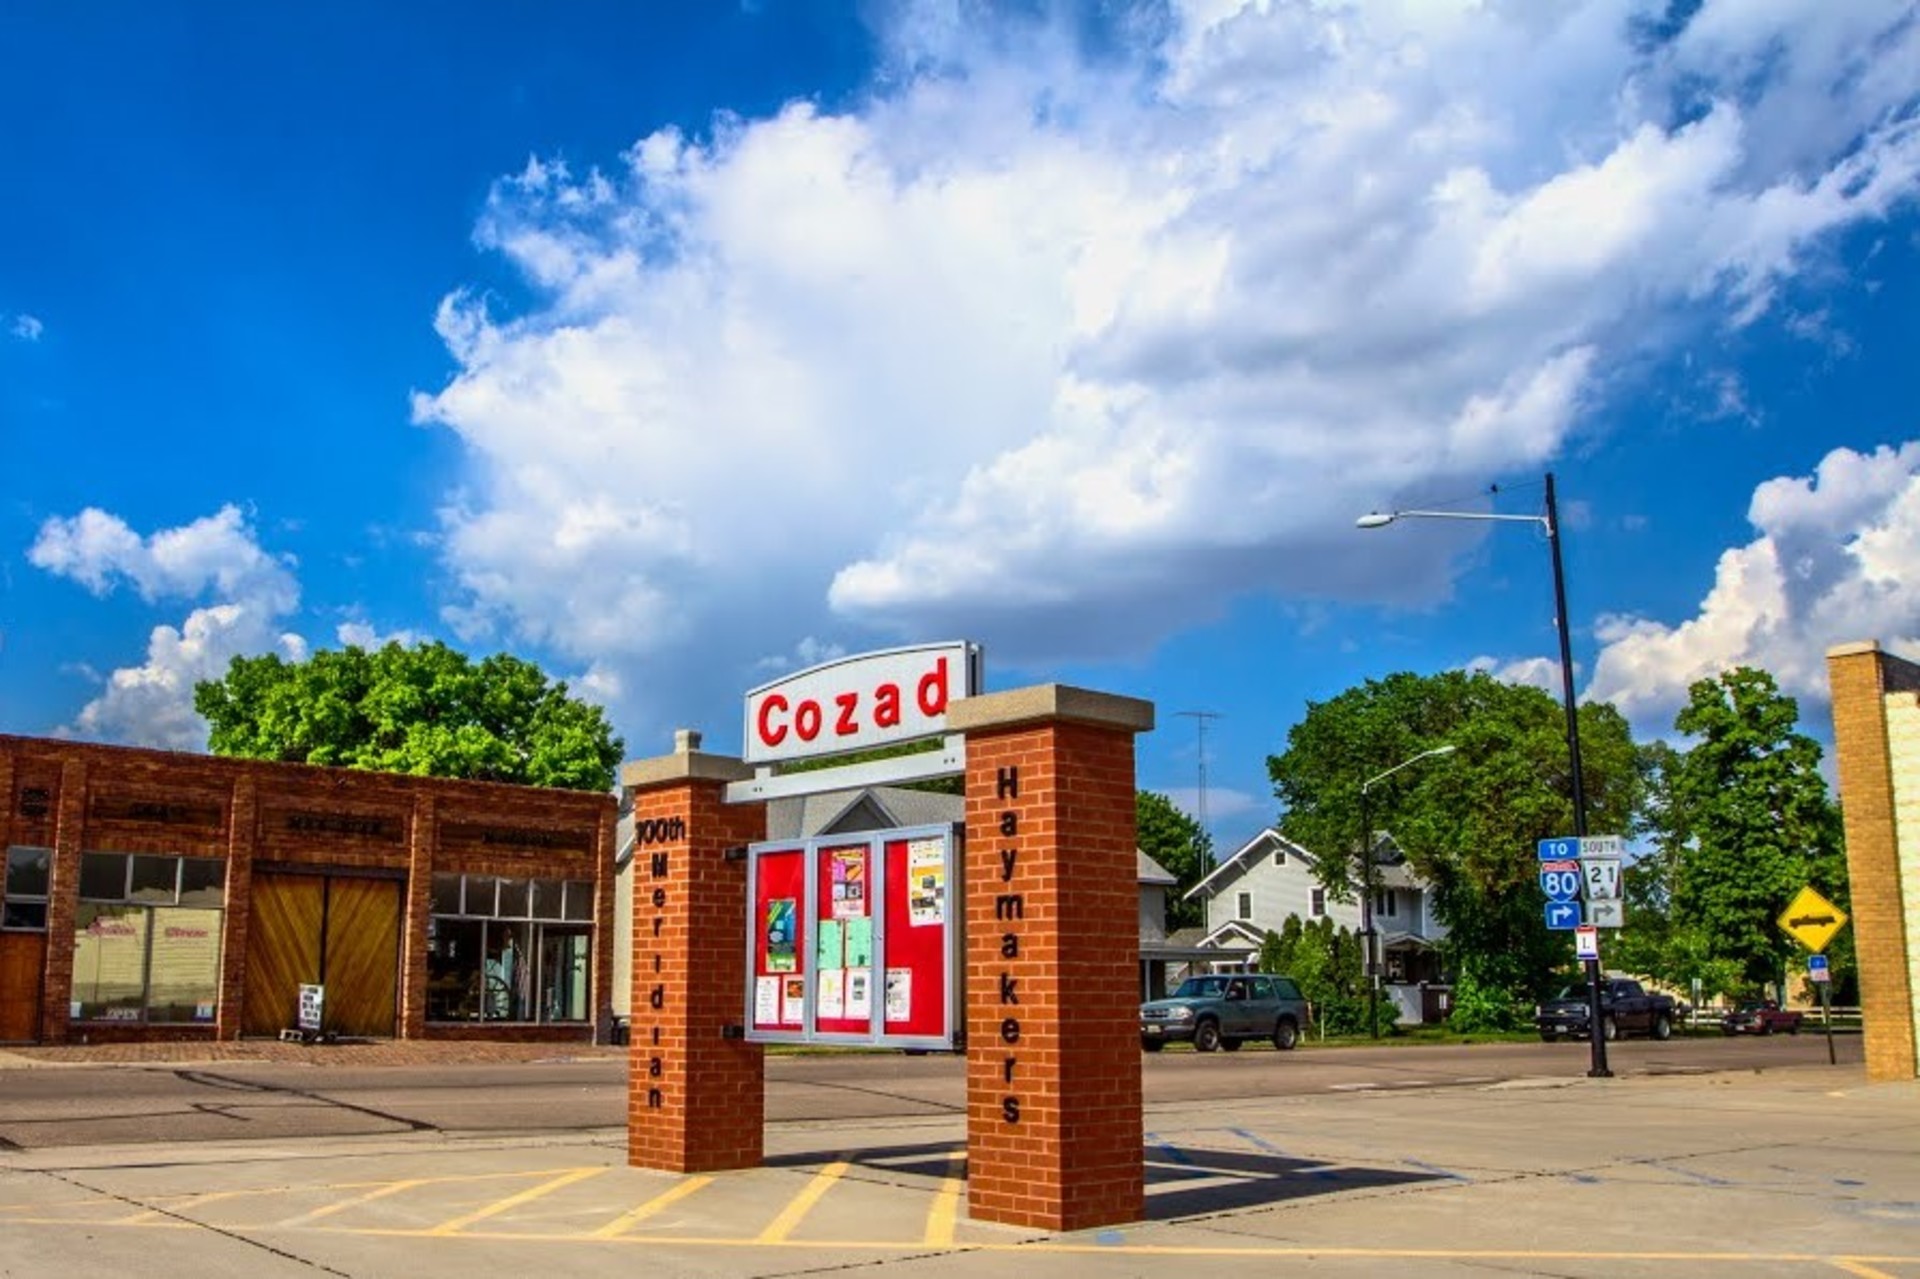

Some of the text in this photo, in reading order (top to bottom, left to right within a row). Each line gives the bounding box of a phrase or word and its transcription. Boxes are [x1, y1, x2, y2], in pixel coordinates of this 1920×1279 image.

[758, 657, 948, 746] Cozad
[635, 816, 686, 845] 100th
[1549, 843, 1568, 855] TO
[1582, 841, 1616, 853] SOUTH
[1546, 873, 1577, 895] 80
[1591, 867, 1614, 883] 21
[996, 766, 1024, 1124] Haymakers
[649, 852, 668, 1109] Meridian
